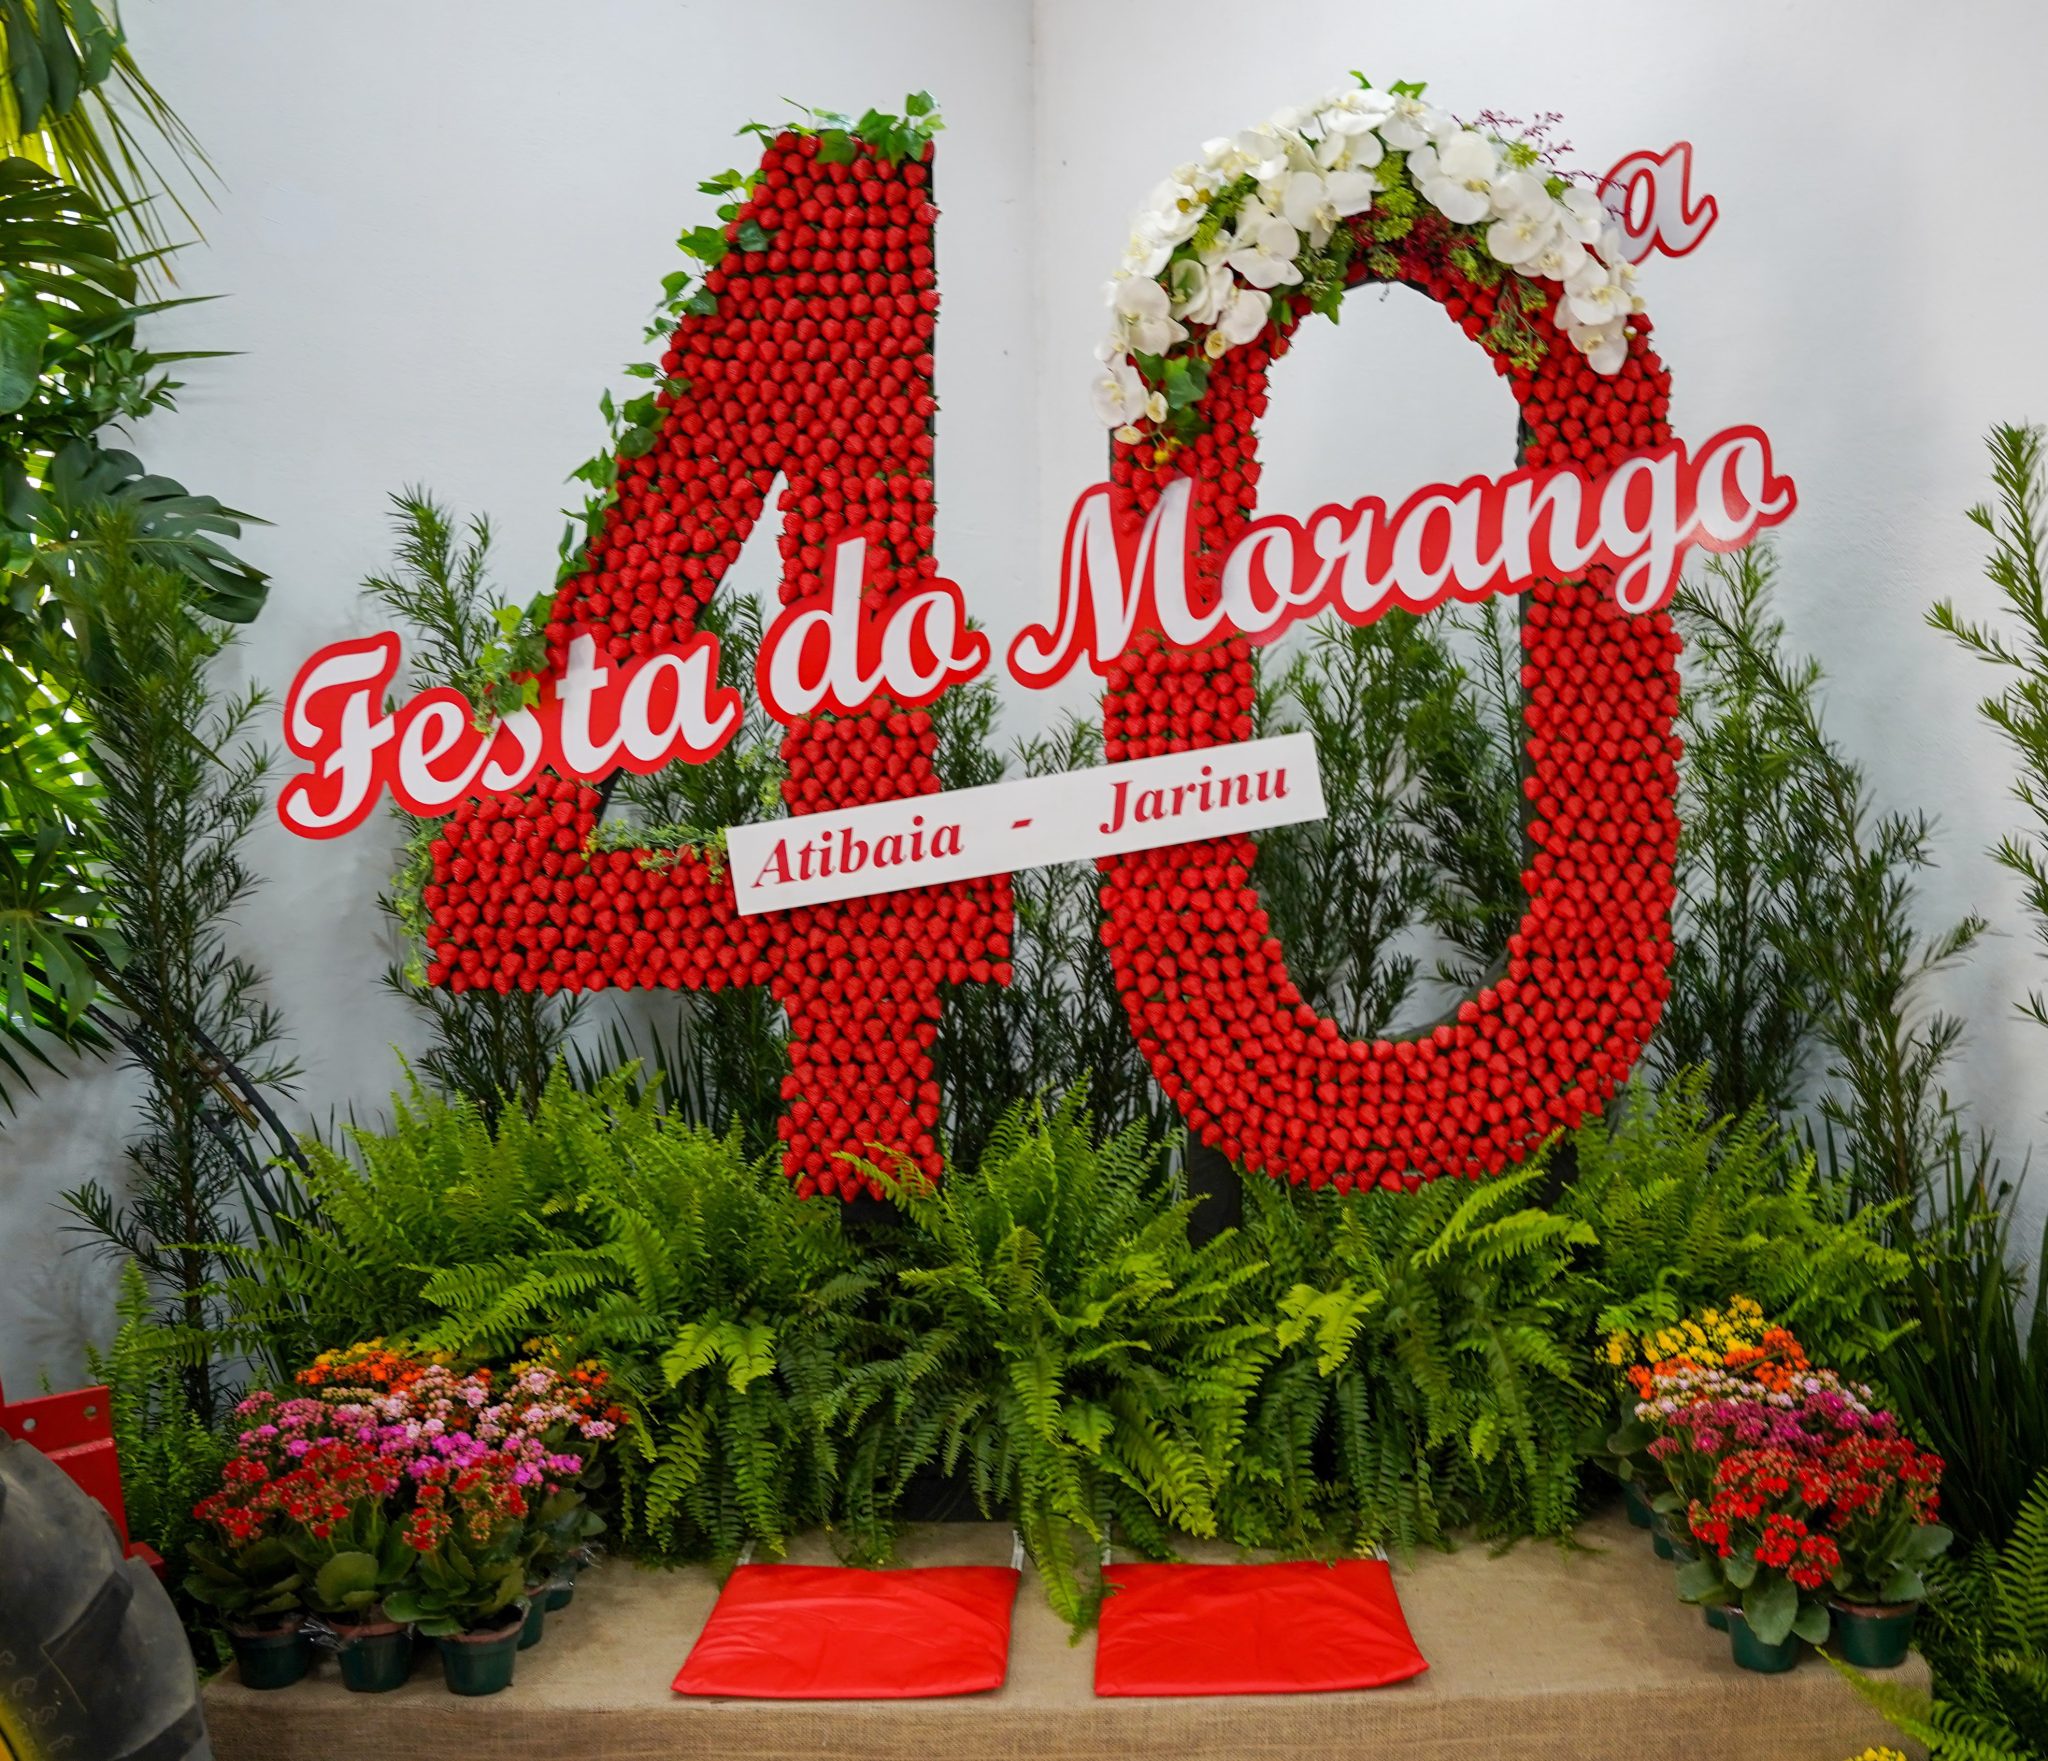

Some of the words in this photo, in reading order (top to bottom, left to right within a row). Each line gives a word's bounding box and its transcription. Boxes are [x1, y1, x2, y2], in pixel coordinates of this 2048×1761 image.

[281, 630, 740, 834] Festa
[765, 532, 986, 720] do
[1009, 430, 1793, 682] Morango
[751, 815, 964, 888] Atibaia
[1099, 765, 1290, 835] Jarinu
